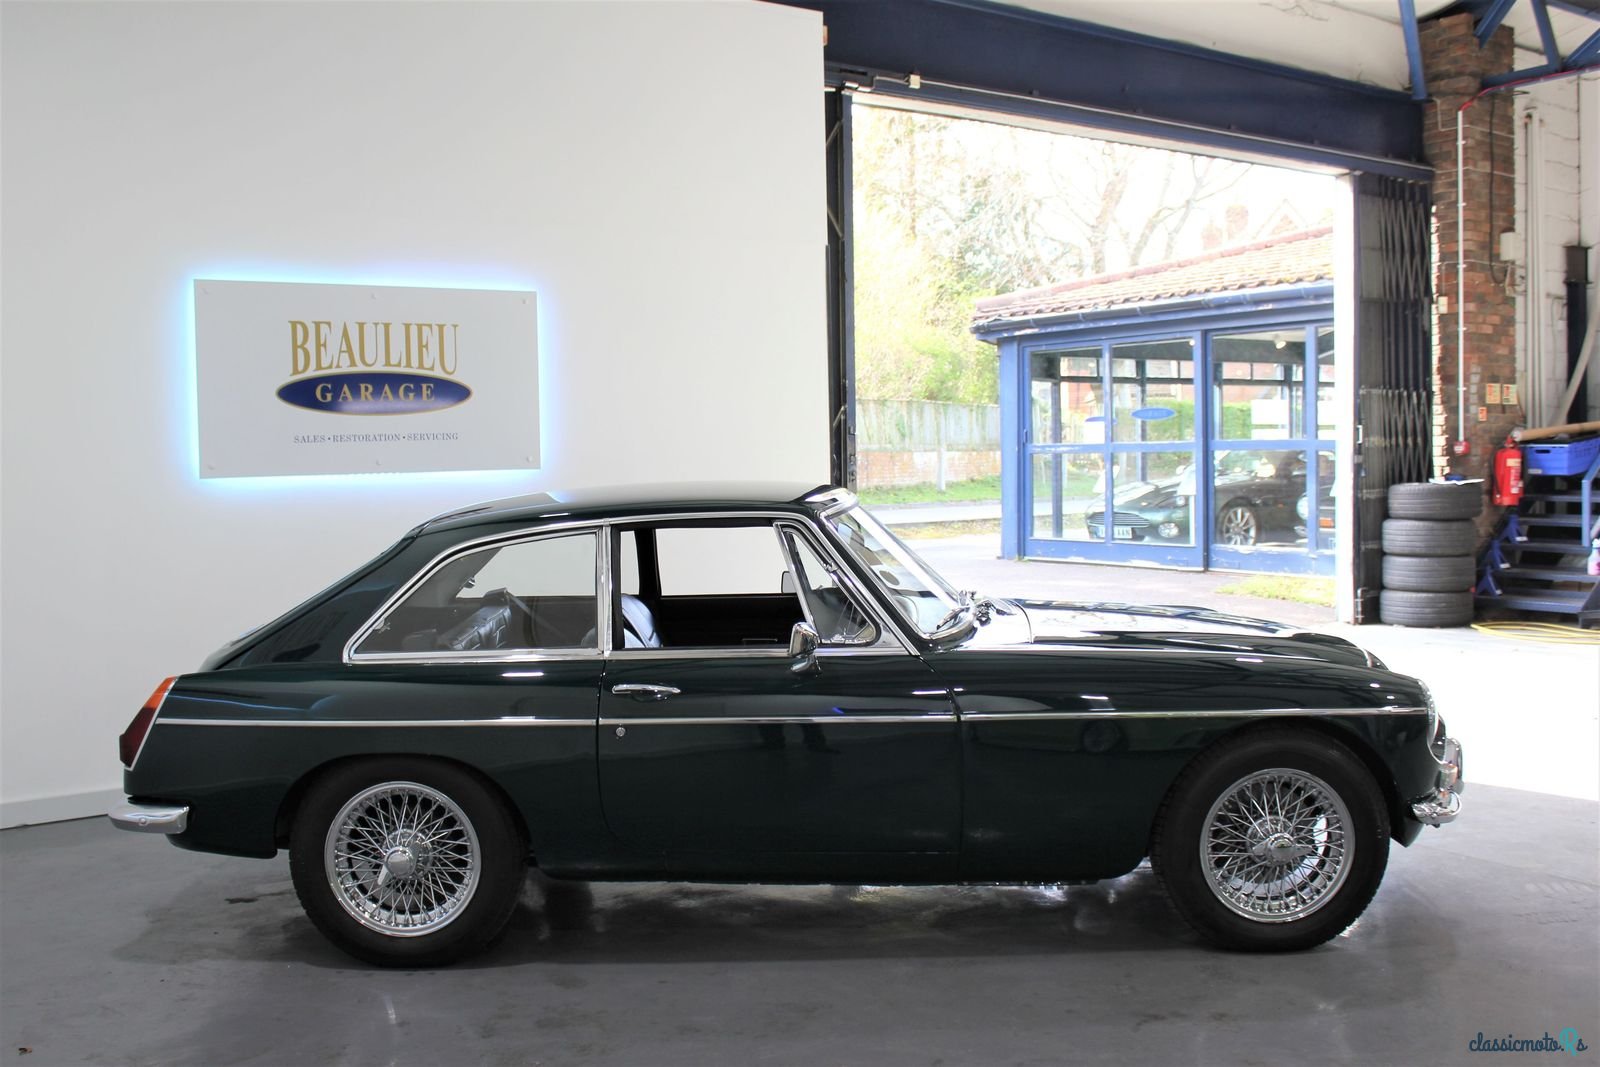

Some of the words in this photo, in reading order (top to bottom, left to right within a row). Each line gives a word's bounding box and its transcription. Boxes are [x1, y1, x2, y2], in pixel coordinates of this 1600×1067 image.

[288, 320, 459, 377] BEAULIEU
[315, 383, 435, 403] GARAGE
[294, 434, 326, 444] SALES
[332, 433, 401, 443] RESTORATION
[406, 432, 459, 442] SERVICING
